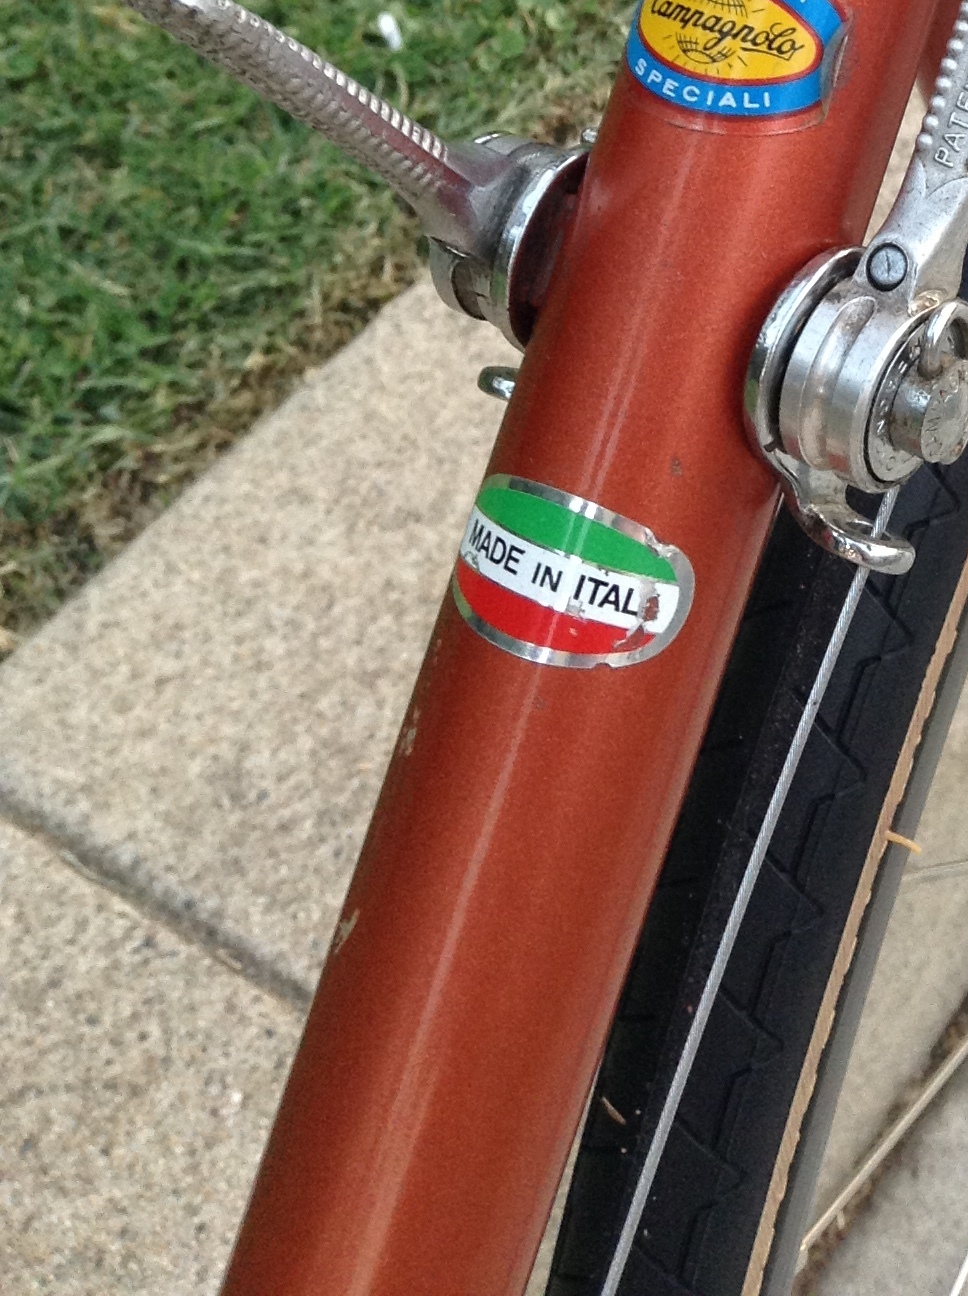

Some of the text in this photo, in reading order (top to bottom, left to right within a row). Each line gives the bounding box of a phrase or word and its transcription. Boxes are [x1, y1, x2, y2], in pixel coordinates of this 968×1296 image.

[634, 57, 771, 109] SPECIALI
[468, 518, 645, 617] MADE IN ITAL
